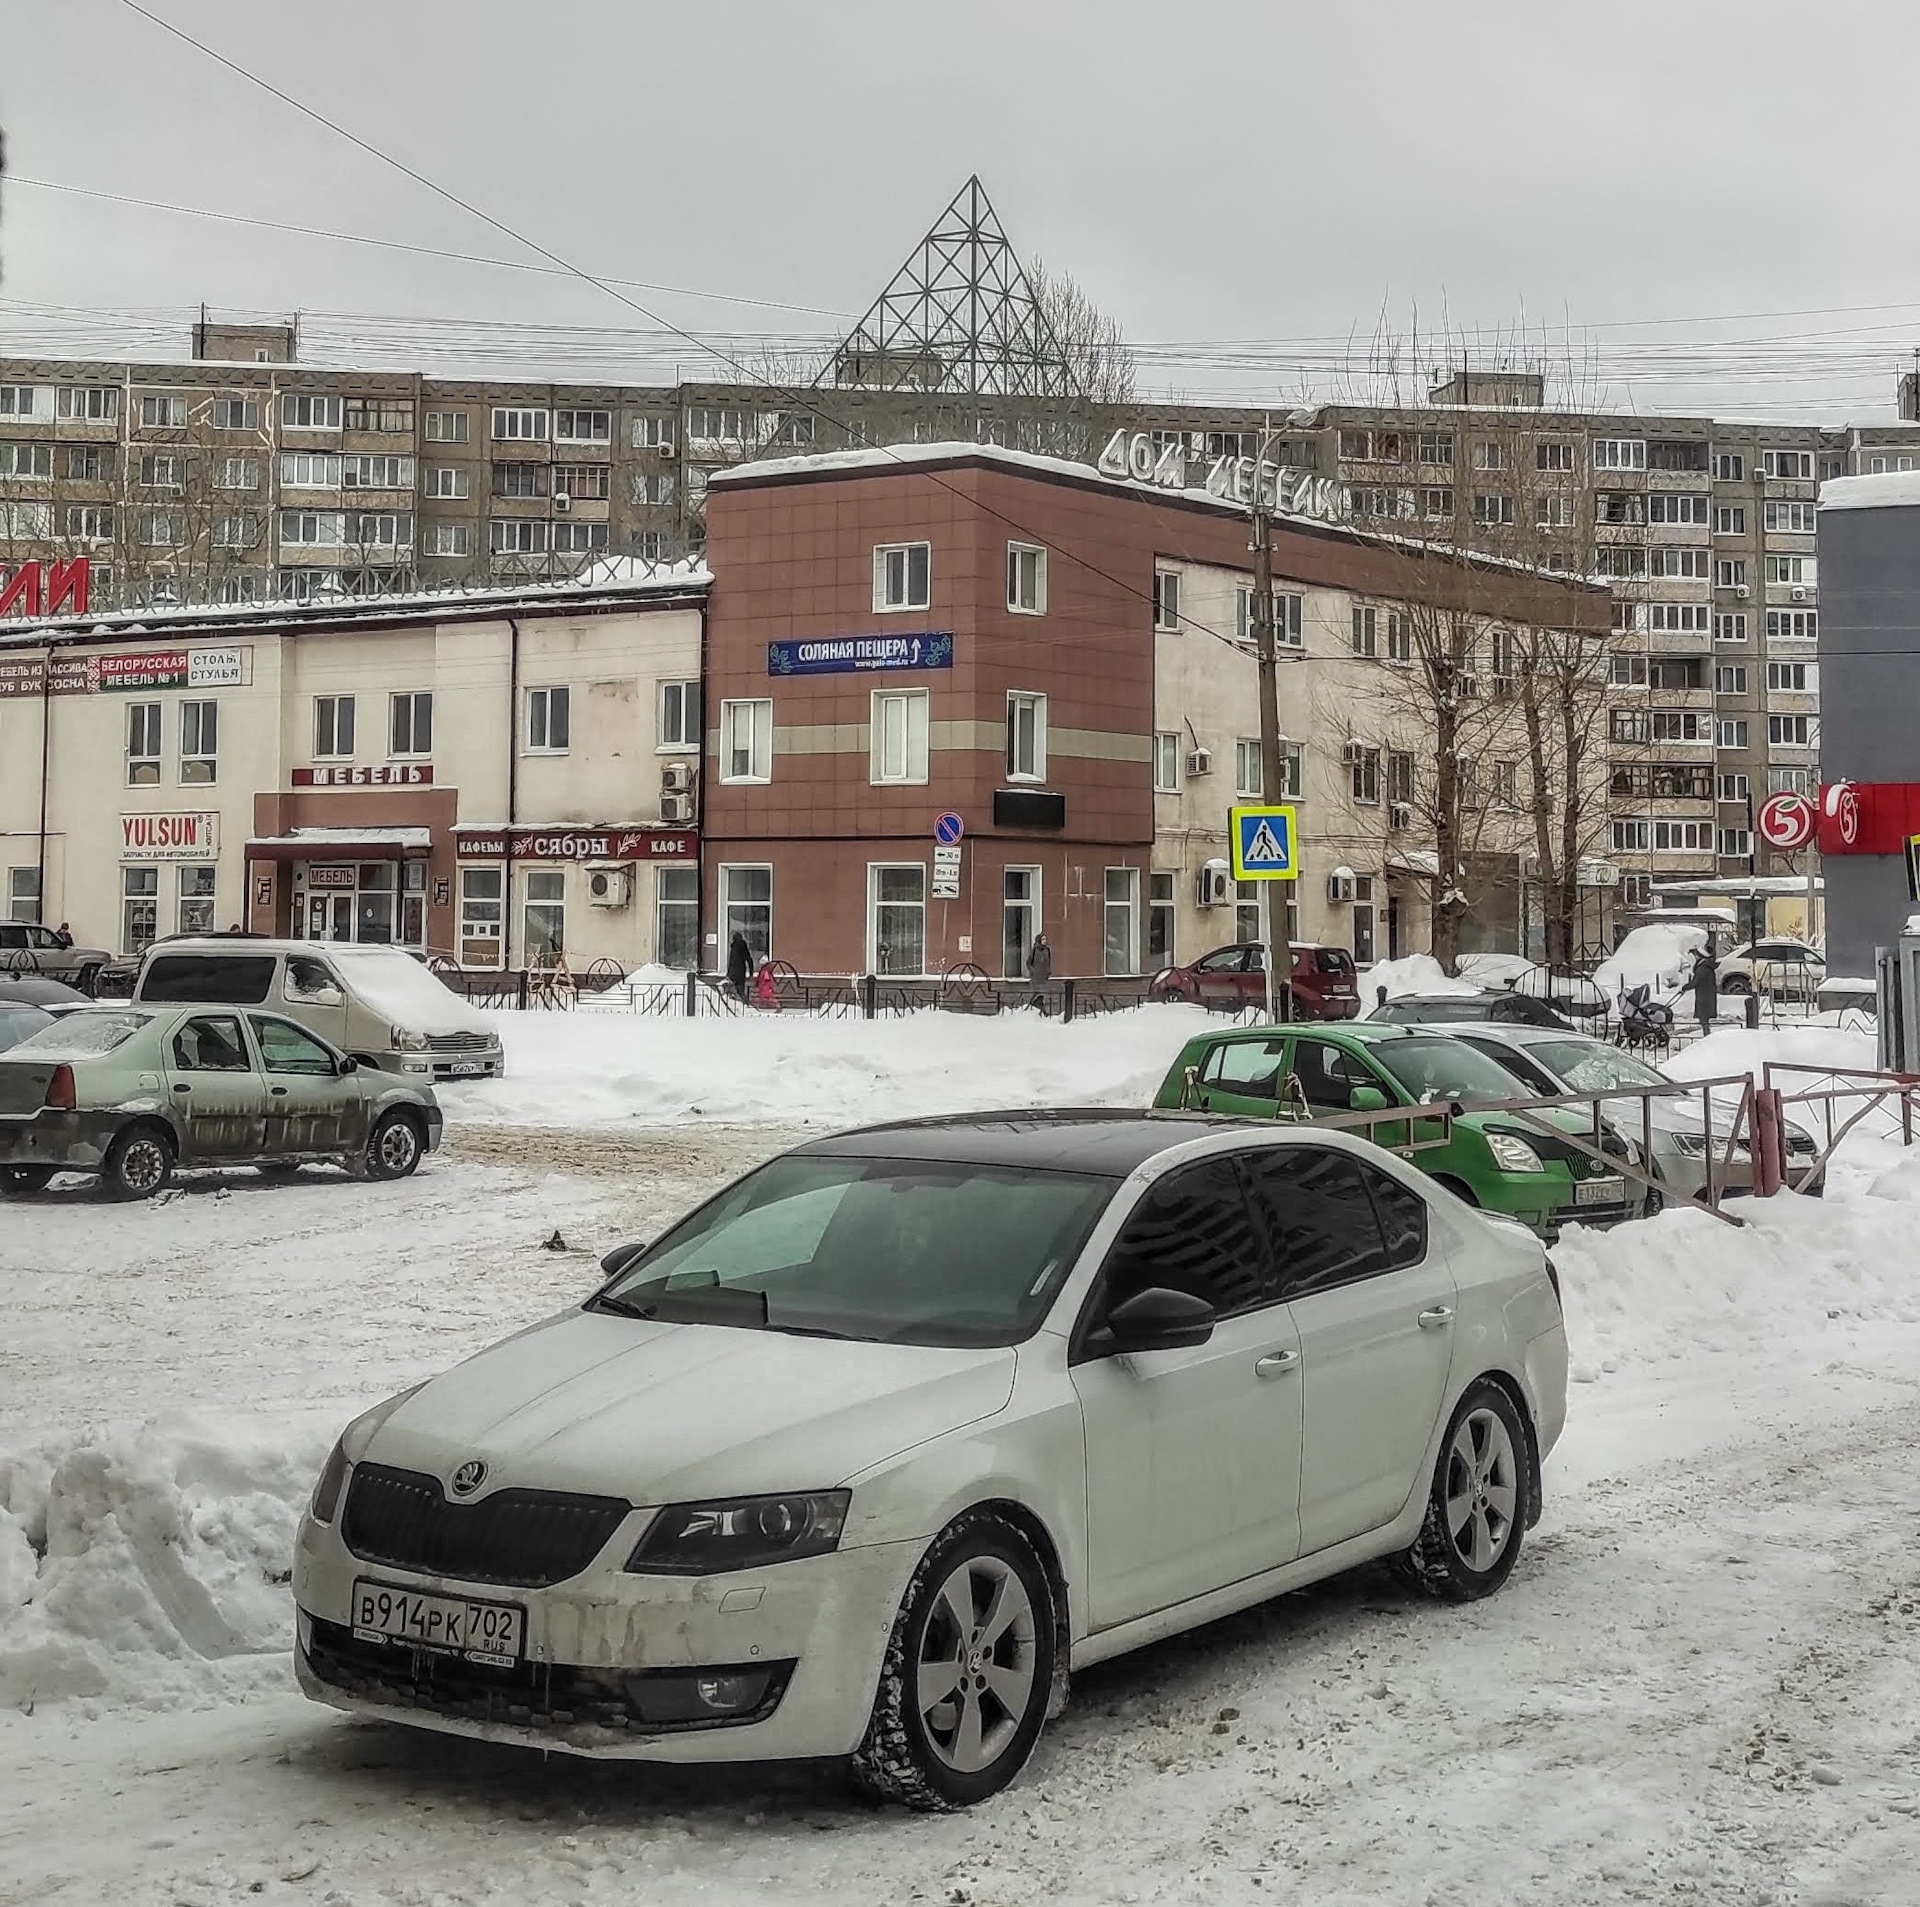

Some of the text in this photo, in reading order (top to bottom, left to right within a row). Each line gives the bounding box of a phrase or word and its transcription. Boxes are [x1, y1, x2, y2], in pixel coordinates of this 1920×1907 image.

[1099, 428, 1185, 488] ДОМ
[798, 638, 909, 662] СОЛЯНАЯ ПЕЩЕРА
[101, 656, 187, 672] БЕЛОРУССКАЯ
[193, 653, 237, 666] СТОЛЫ
[0, 665, 30, 677] ЕБЕЛЬ
[31, 664, 43, 676] ИЗ
[191, 668, 239, 681] СТУЛЬЯ
[20, 680, 42, 692] БУК
[106, 673, 155, 687] МЕБЕЛЬ
[172, 671, 179, 683] 1
[312, 765, 423, 785] МЕБЕЛЬ
[122, 816, 197, 847] YULSUN
[1772, 810, 1799, 843] 5
[650, 840, 687, 854] КАФЕ
[361, 1592, 513, 1643] В914РК 702
[483, 1638, 505, 1650] RUS
